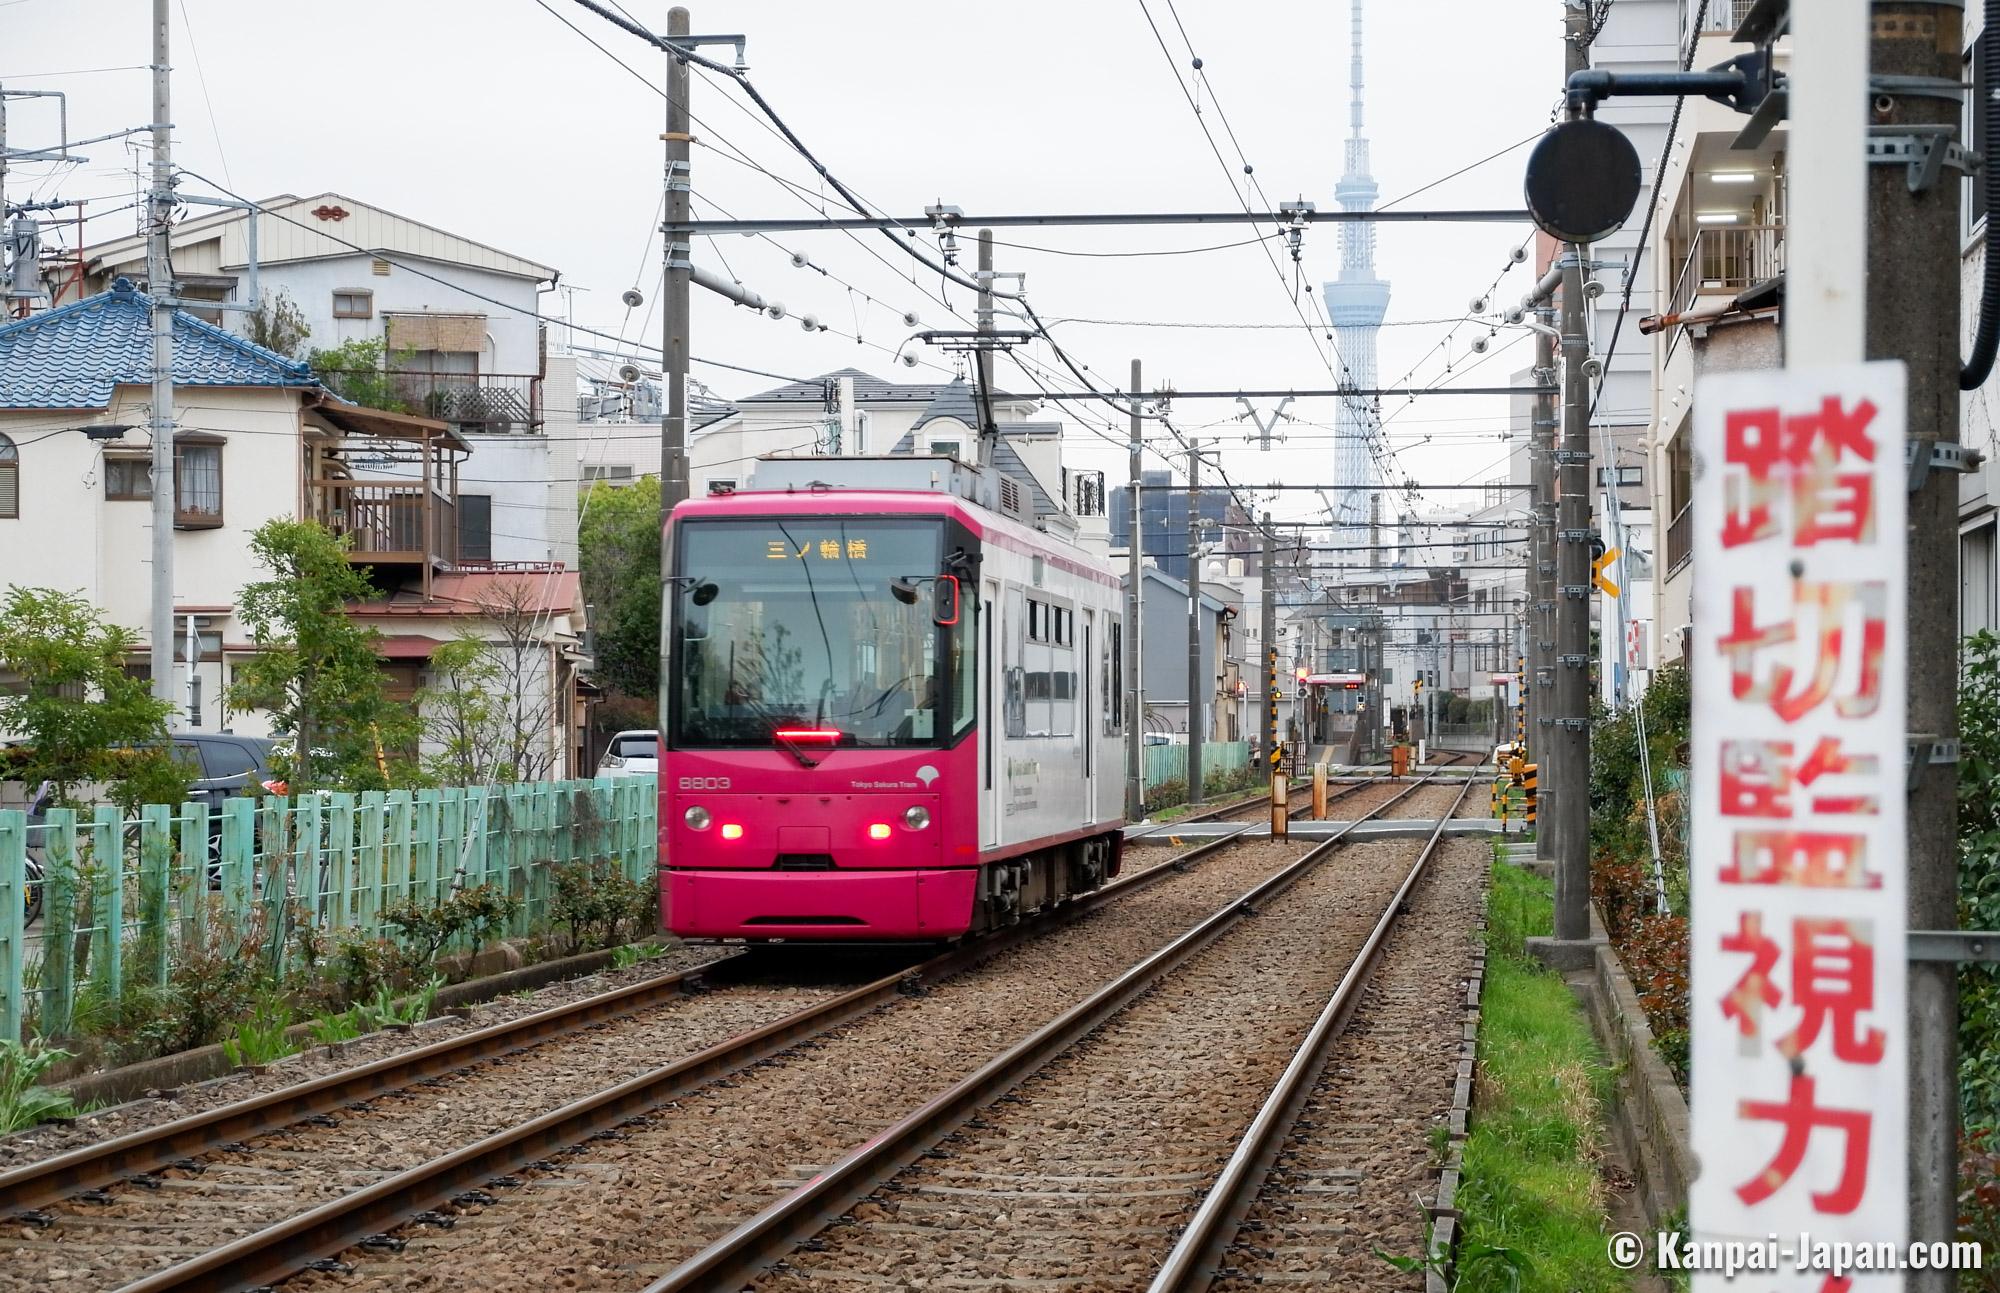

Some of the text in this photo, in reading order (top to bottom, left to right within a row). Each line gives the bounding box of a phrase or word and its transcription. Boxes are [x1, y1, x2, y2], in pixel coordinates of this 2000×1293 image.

[766, 539, 868, 559] 三ノ輪橋
[678, 776, 731, 790] 8803
[851, 780, 917, 789] Tokyo Sakura Tram
[1717, 395, 1888, 1293] 踏切監視カ
